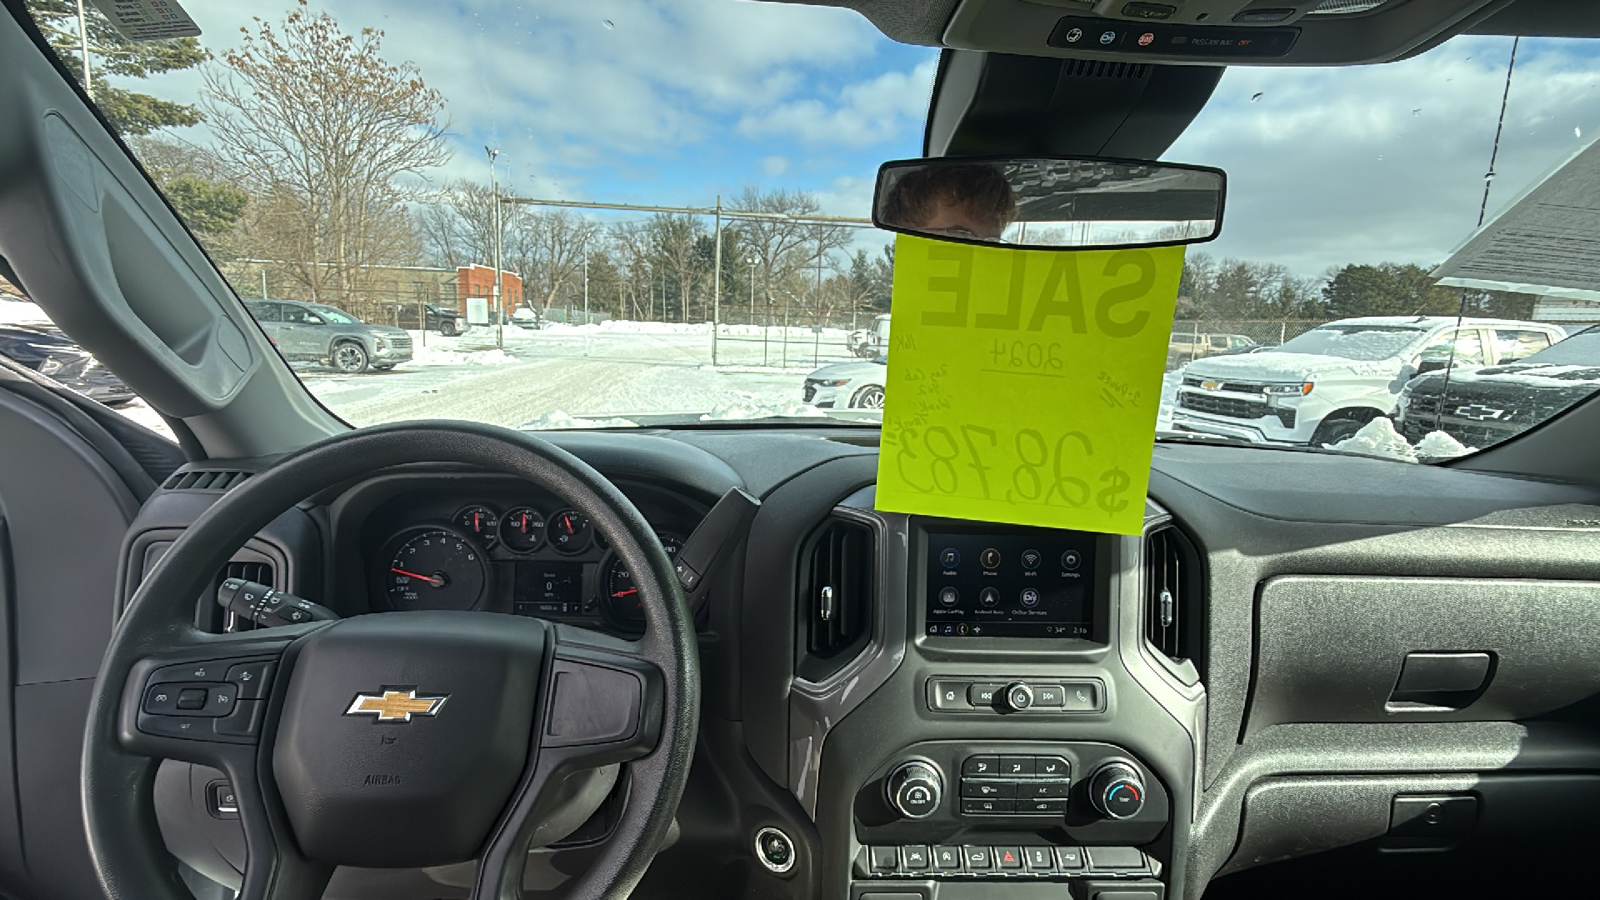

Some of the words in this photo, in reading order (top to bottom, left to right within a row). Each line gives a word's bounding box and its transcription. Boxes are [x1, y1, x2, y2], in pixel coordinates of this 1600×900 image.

[546, 581, 552, 590] 0
[1073, 626, 1088, 634] 2:16
[364, 774, 402, 786] AIRBAG
